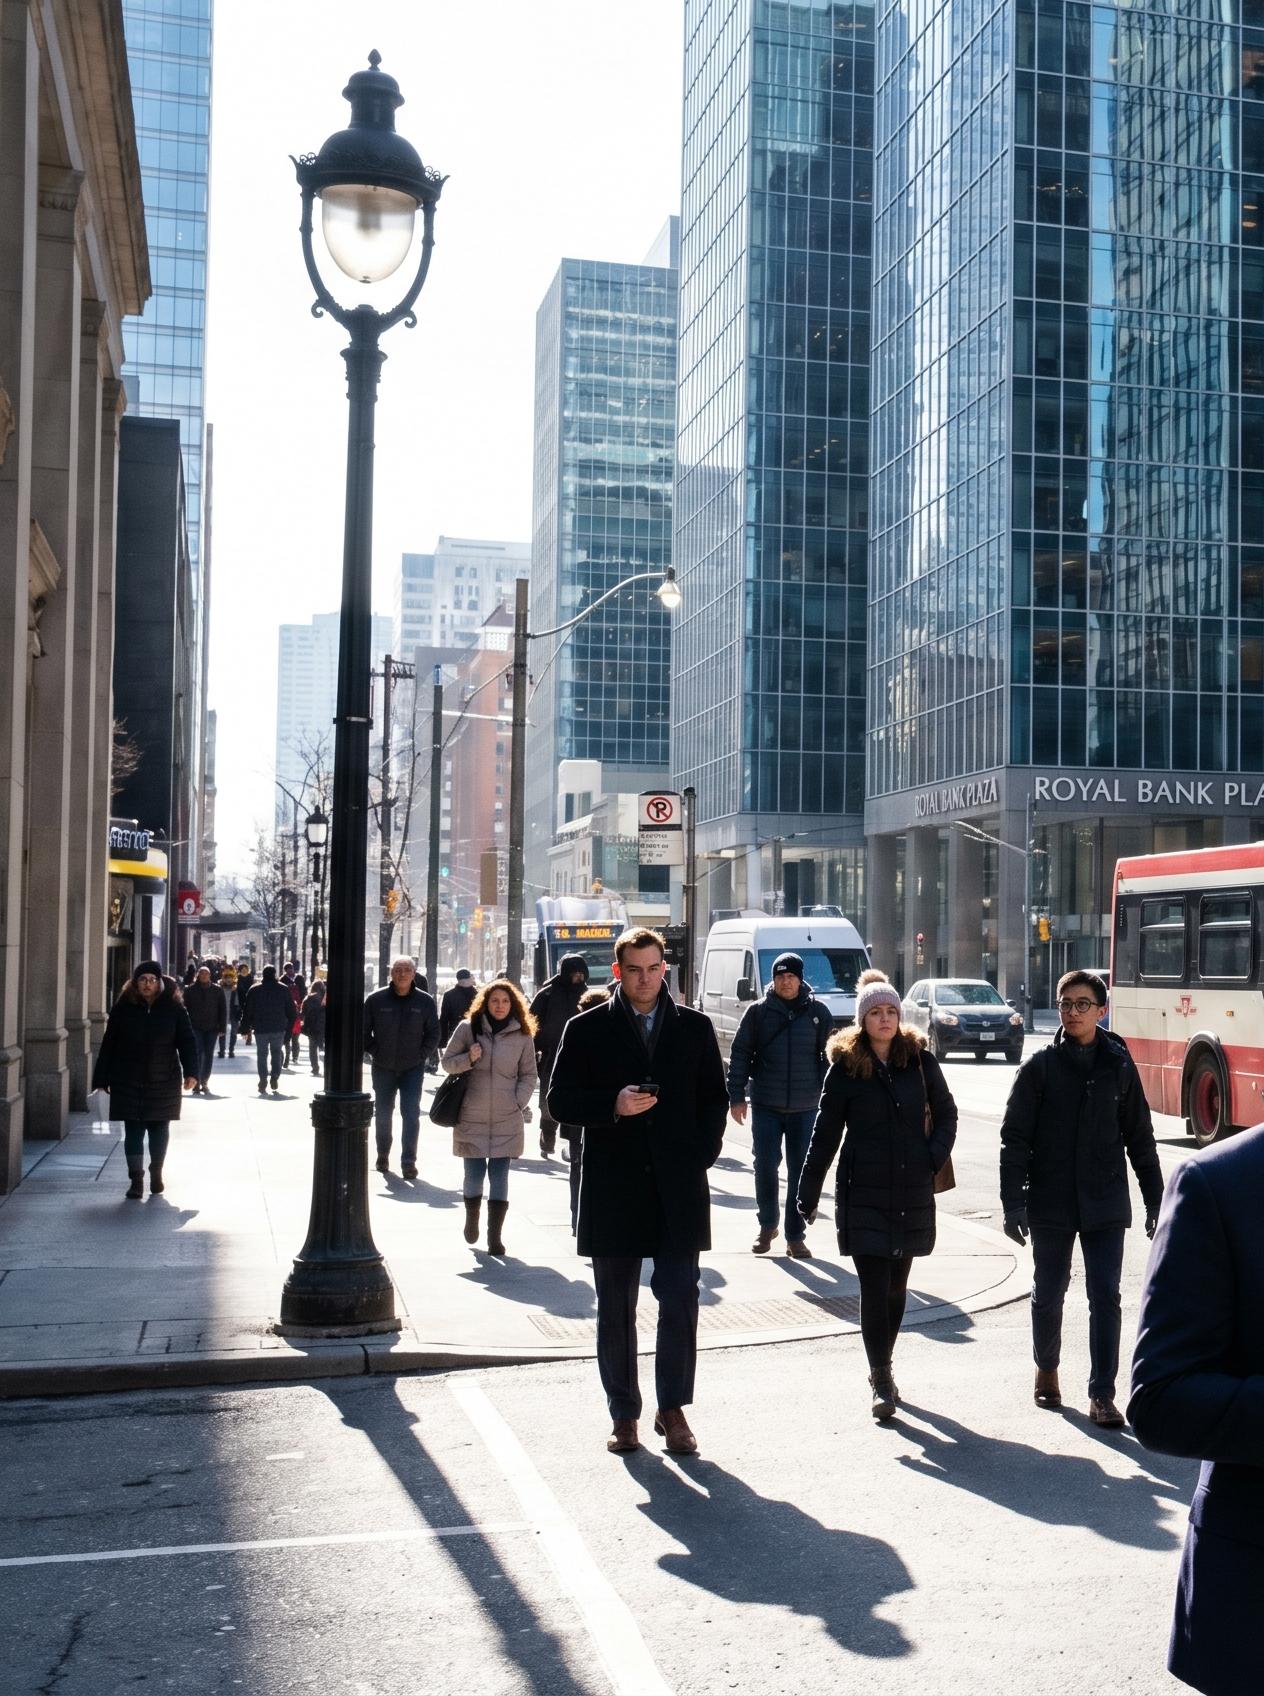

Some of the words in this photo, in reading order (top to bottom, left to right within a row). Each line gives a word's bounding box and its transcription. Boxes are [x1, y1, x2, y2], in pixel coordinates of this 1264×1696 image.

[942, 785, 965, 812] BANK
[966, 777, 997, 807] PLAZA
[1035, 776, 1127, 802] ROYAL
[1138, 779, 1214, 805] BANK
